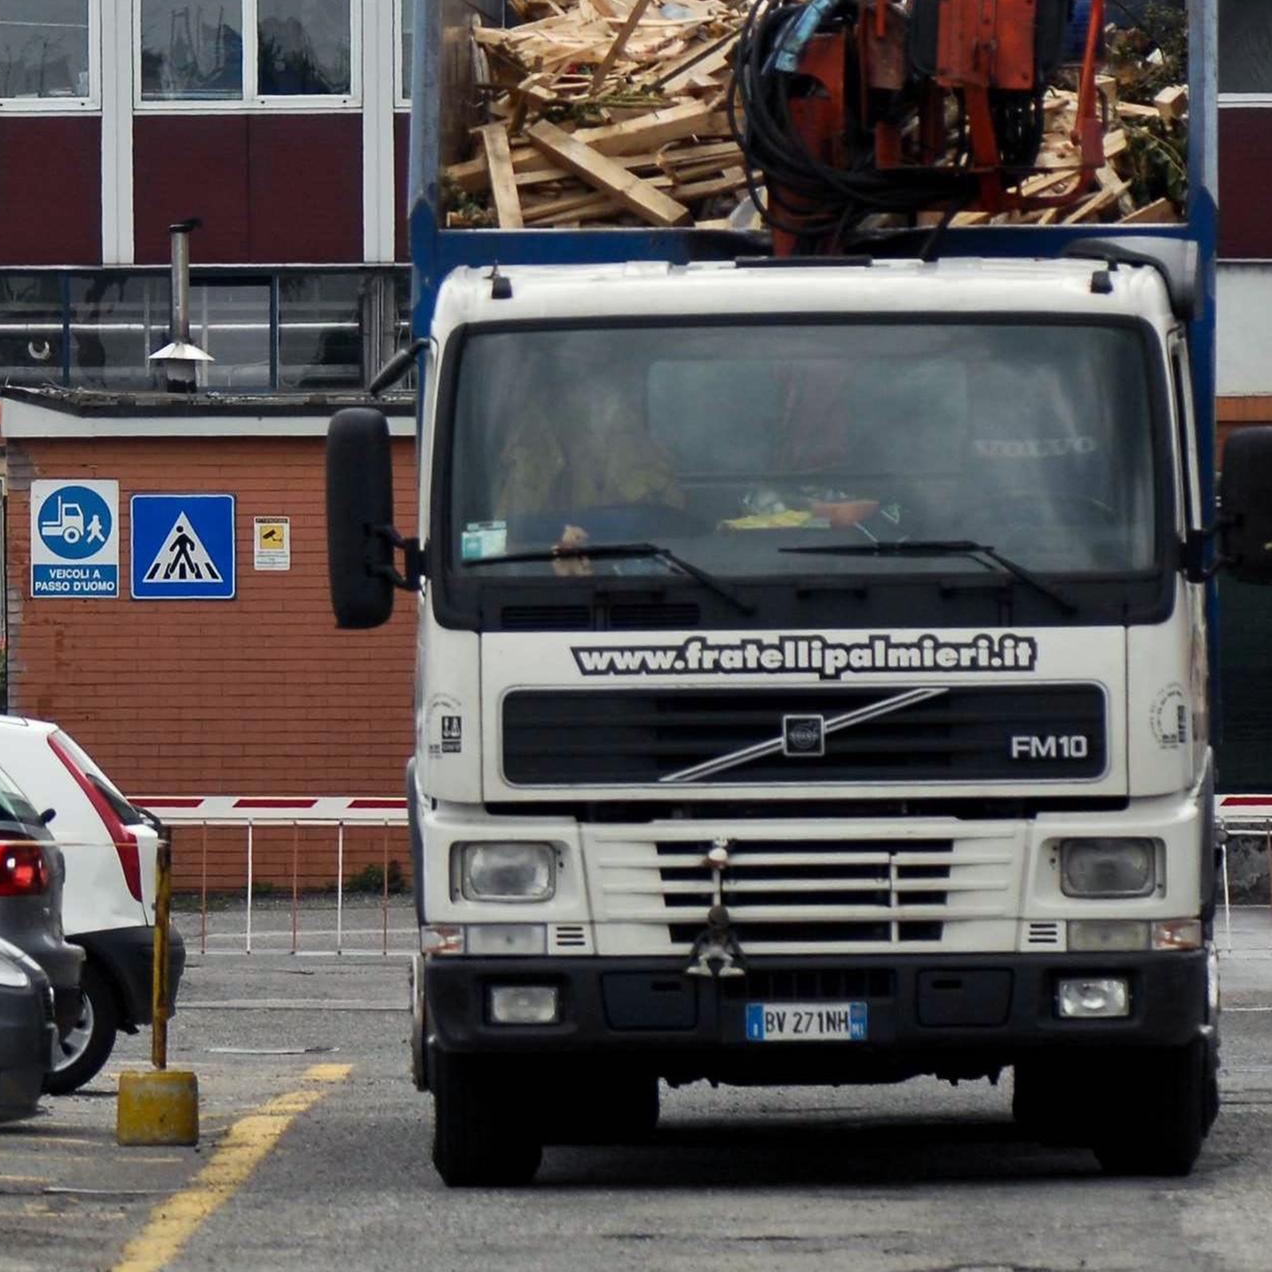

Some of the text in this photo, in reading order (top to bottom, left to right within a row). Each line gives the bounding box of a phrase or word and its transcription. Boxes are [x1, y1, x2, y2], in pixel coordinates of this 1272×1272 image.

[49, 569, 101, 579] VEICOLI A
[35, 581, 115, 591] PASSO D'UOMO
[577, 636, 1035, 676] www.fratellipalmieri.it
[1011, 735, 1088, 758] FM10
